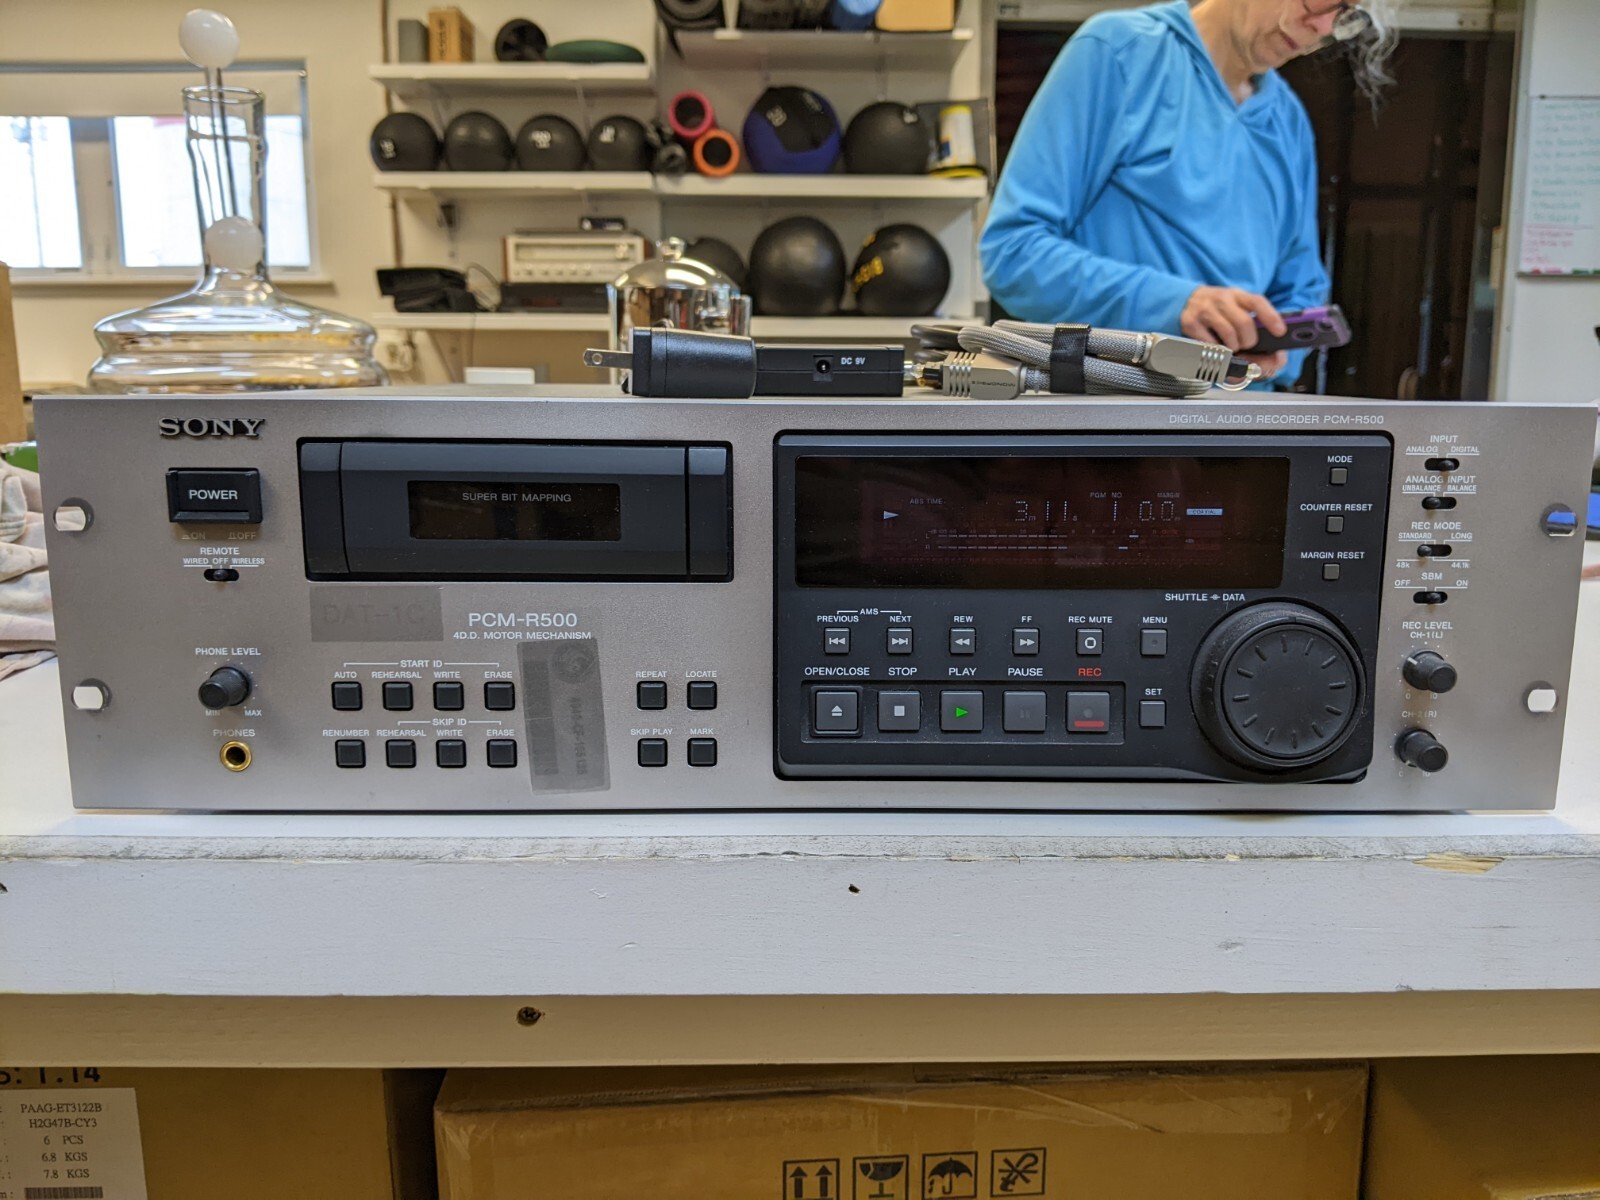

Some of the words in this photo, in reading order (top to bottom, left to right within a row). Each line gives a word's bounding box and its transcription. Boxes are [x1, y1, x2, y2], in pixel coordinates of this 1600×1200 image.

[841, 357, 853, 366] DC
[855, 357, 865, 366] 9V
[1169, 415, 1212, 424] DIGITAL
[1216, 415, 1252, 424] AUDIO
[1256, 415, 1319, 424] RECORDER
[1323, 415, 1384, 424] PCM-R500
[159, 416, 265, 439] SONY
[1430, 435, 1458, 443] INPUT
[1405, 475, 1443, 484] ANALOG
[1448, 475, 1476, 484] INPUT
[1402, 484, 1441, 492] UNBALANCE
[1447, 484, 1477, 492] BALANCE
[189, 489, 238, 500] POWER
[462, 492, 498, 502] SUPER
[502, 493, 518, 502] BIT
[522, 493, 572, 503] MAPPING
[1300, 504, 1342, 512] COUNTER
[1345, 504, 1372, 512] RESET
[1411, 522, 1431, 530] REC
[1434, 522, 1461, 530] MODE
[200, 547, 240, 555] REMOTE
[1421, 572, 1443, 580] SBM
[468, 612, 578, 627] PCM-R500
[889, 615, 912, 623] NEXT
[1402, 622, 1421, 630] REC
[1424, 622, 1453, 630] LEVEL
[484, 632, 522, 640] MOTOR
[526, 632, 591, 640] MECHANISM
[195, 648, 228, 656] PHONE
[231, 648, 261, 656] LEVEL
[400, 660, 430, 668] START
[433, 660, 443, 668] ID
[804, 667, 870, 676] OPEN/CLOSE
[888, 667, 917, 676] STOP
[948, 667, 977, 676] PLAY
[1007, 667, 1043, 676] PAUSE
[1078, 668, 1102, 676] REC
[432, 718, 454, 726] SKIP
[457, 718, 467, 726] ID
[213, 729, 255, 737] PHONES
[322, 729, 370, 737] RENUMBER
[376, 729, 426, 737] REHEARSAL
[436, 729, 463, 737] WRITE
[486, 729, 515, 737] ERASE
[21, 1103, 102, 1114] PAAG-ET3122B
[29, 1118, 98, 1128] H2G47B-CY3
[44, 1136, 50, 1145] 6
[62, 1135, 84, 1145] PCS
[42, 1152, 57, 1162] 6.8
[64, 1152, 88, 1162] KGS
[44, 1169, 59, 1179] 7.8
[67, 1169, 90, 1179] KGS
